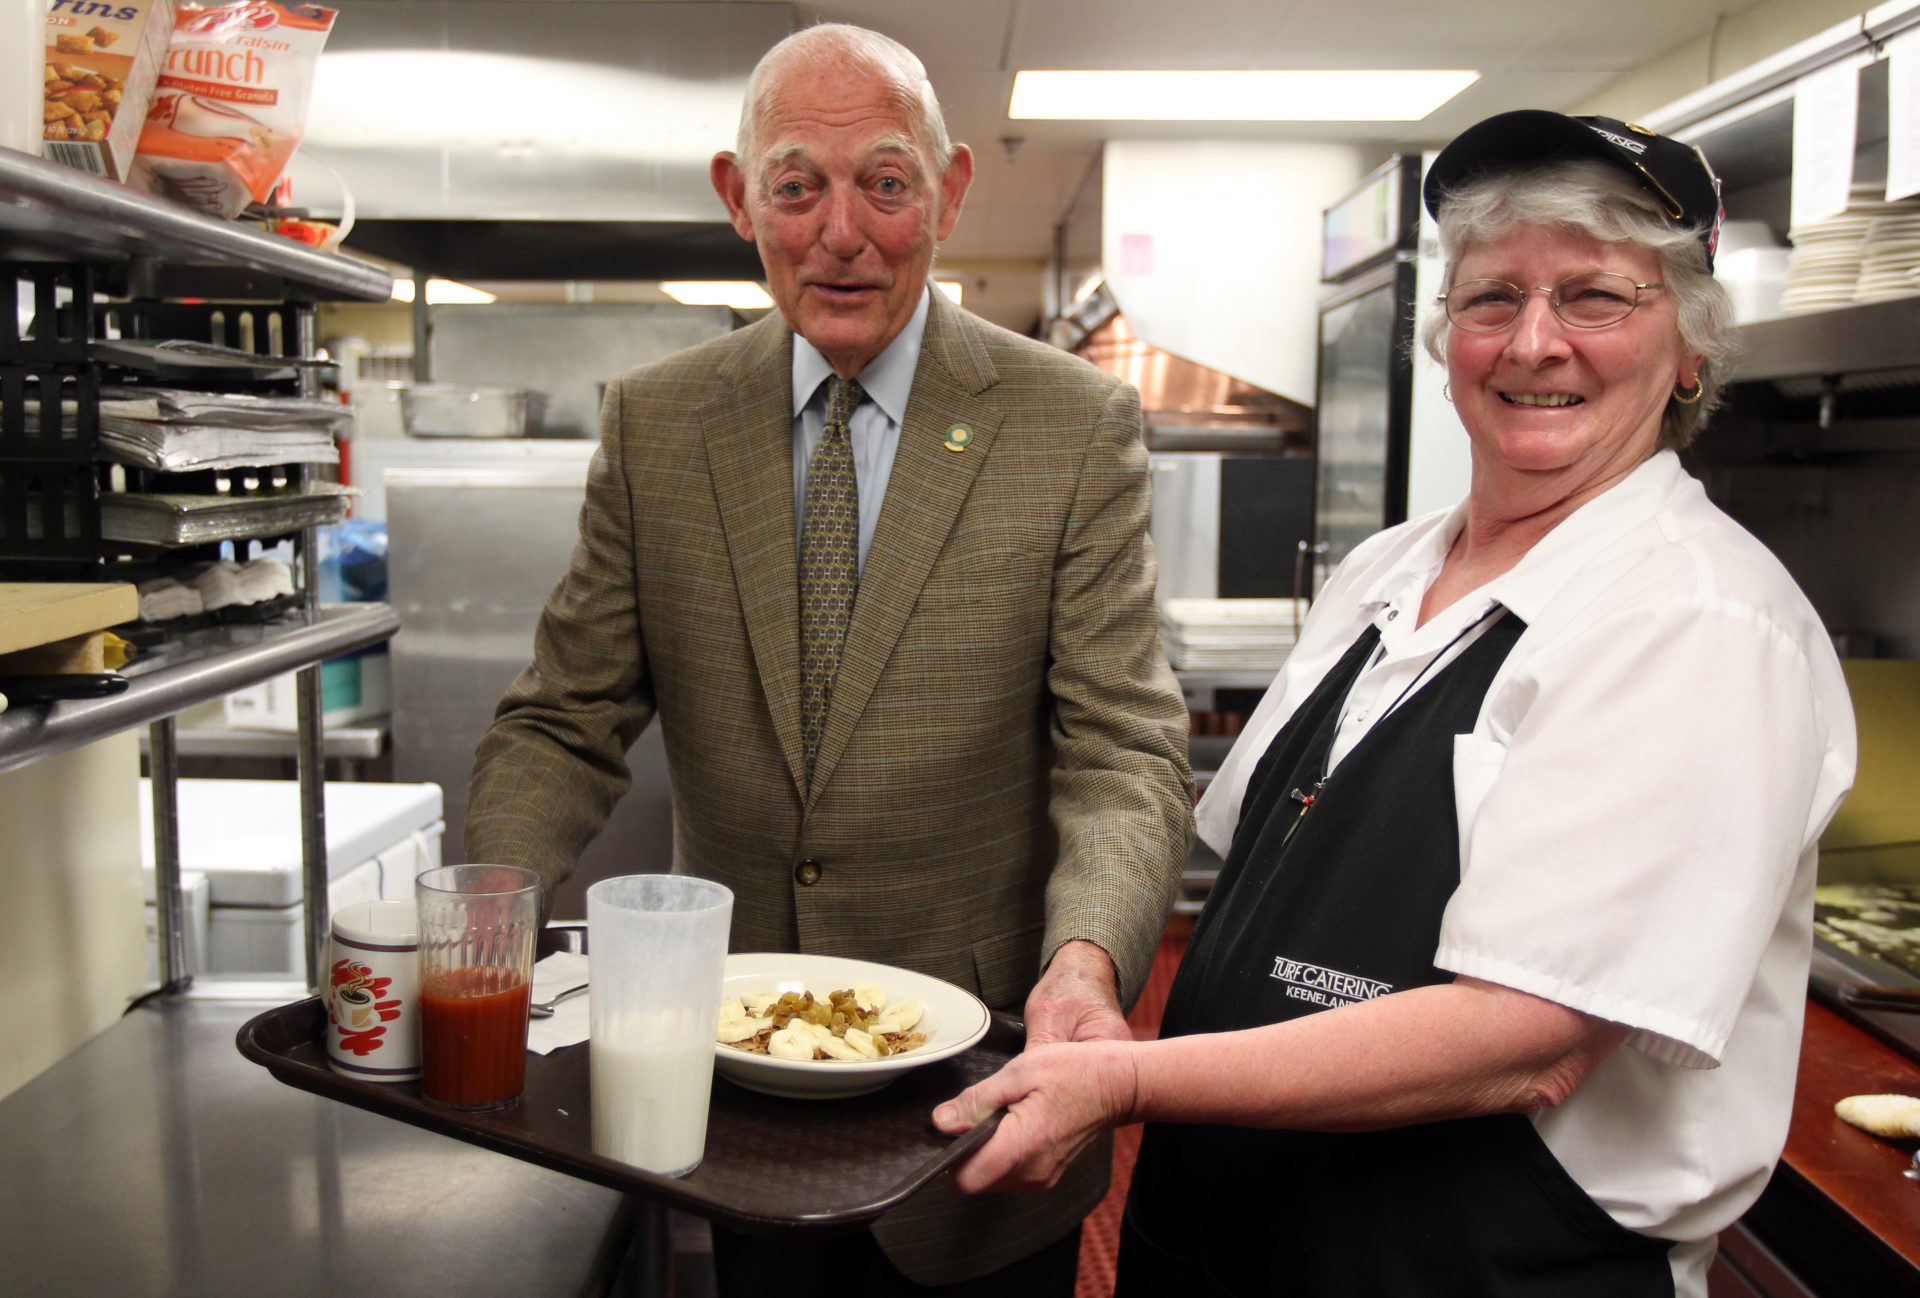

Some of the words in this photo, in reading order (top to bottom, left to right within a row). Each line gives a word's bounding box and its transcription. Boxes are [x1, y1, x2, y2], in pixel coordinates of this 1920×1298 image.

[236, 35, 290, 52] raisin
[162, 48, 265, 85] runch
[209, 86, 233, 98] Free
[1272, 958, 1303, 981] TURF
[1302, 967, 1391, 1000] CATERING
